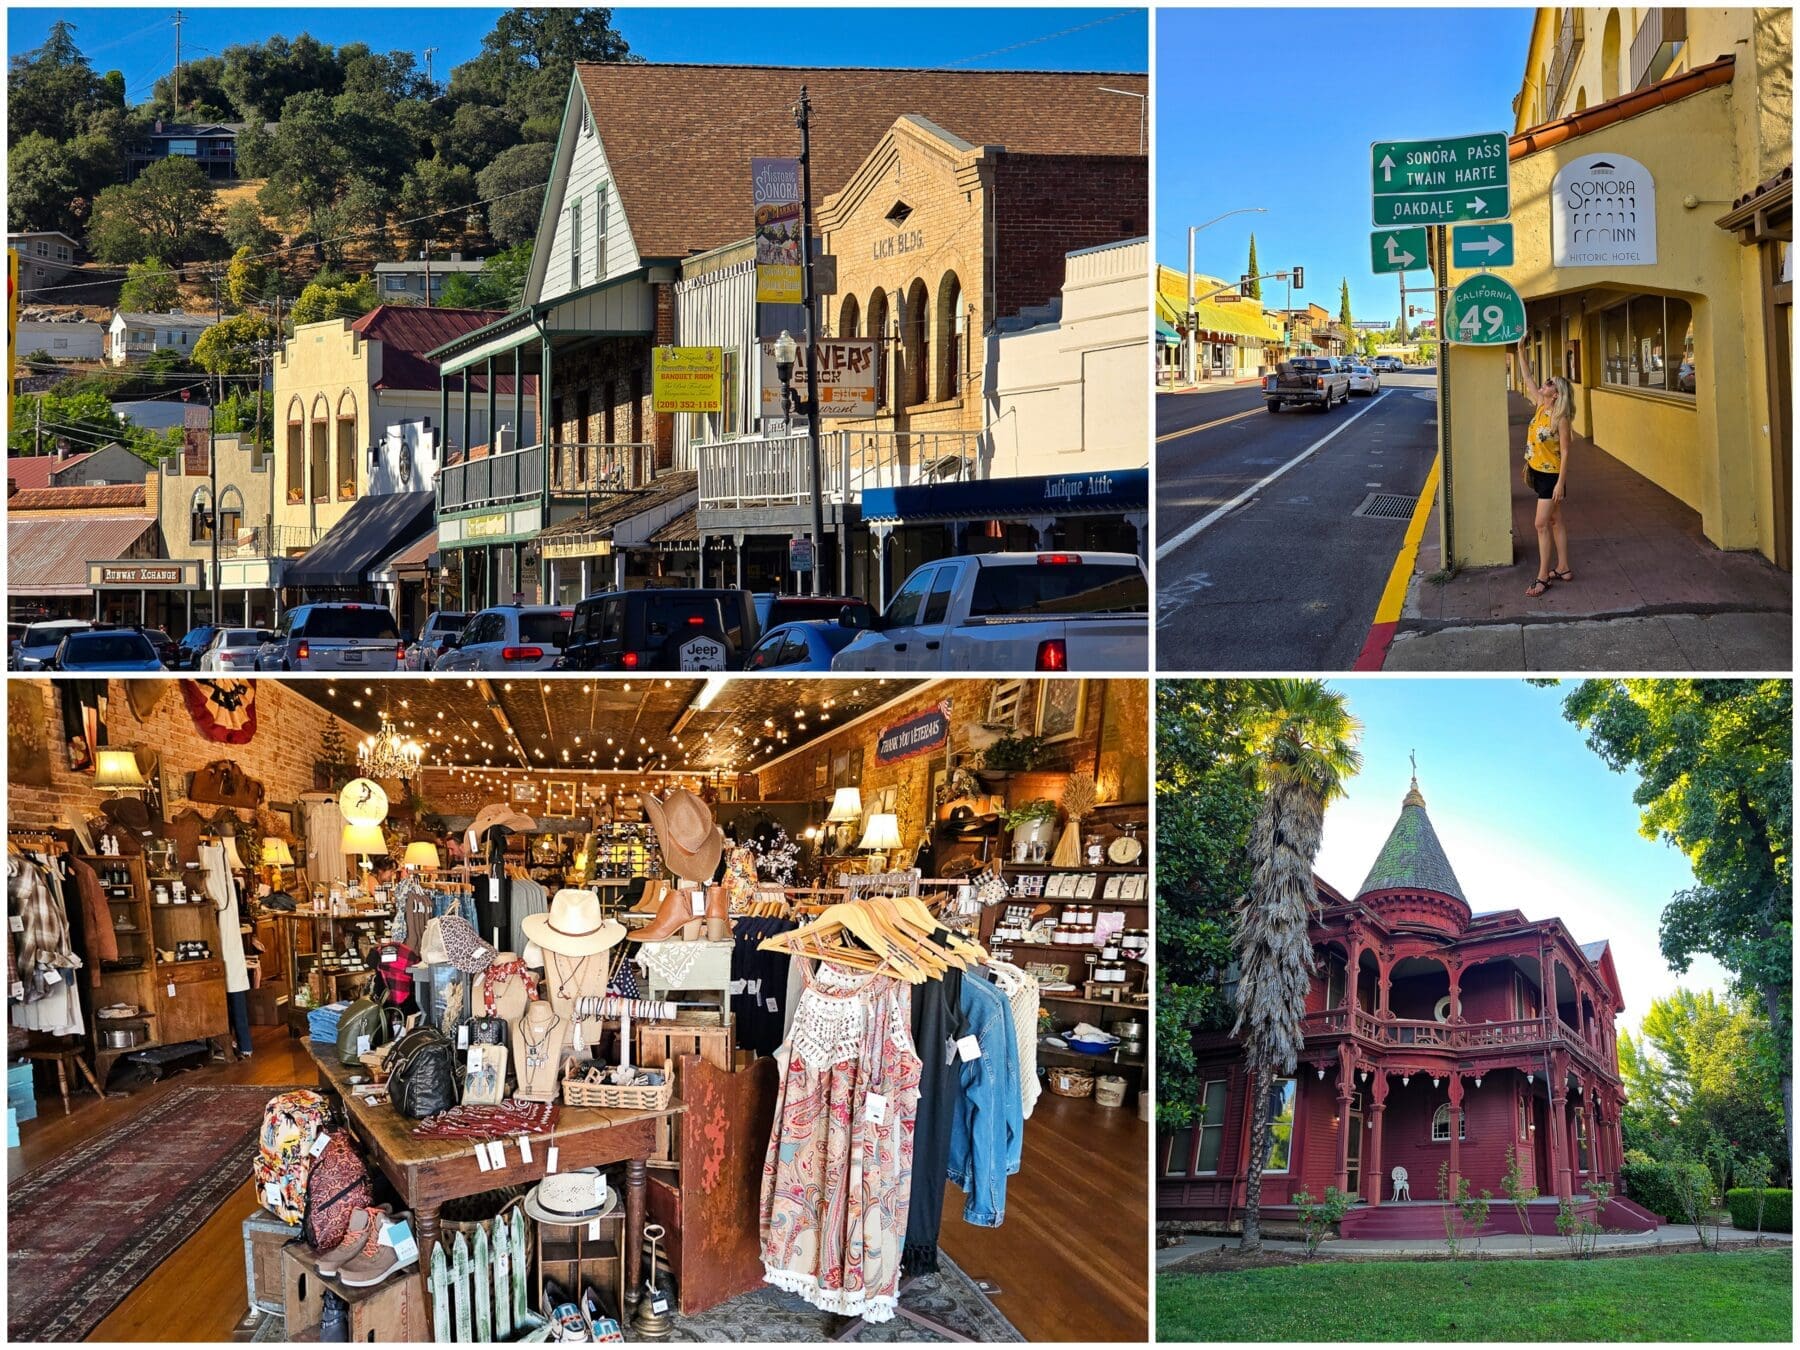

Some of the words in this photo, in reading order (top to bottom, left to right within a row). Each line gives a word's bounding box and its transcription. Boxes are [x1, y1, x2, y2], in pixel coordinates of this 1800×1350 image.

[1406, 149, 1457, 165] SONORA
[1467, 144, 1500, 160] PASS
[1407, 171, 1446, 185] TWAIN
[1455, 166, 1497, 183] HARTE
[755, 176, 799, 201] SONORA
[1568, 180, 1635, 209] SONORA
[1394, 200, 1454, 216] OAKDALE
[1612, 228, 1636, 242] INN
[873, 236, 895, 260] LICK
[1570, 253, 1607, 262] HISTORIC
[1612, 252, 1640, 261] HOTEL
[1456, 290, 1512, 303] CALIFORNIA
[1459, 304, 1504, 336] 49
[795, 343, 873, 374] NERS
[657, 400, 678, 409] (209)
[679, 400, 719, 409] 352-1165
[1044, 478, 1083, 501] Antique
[1086, 475, 1113, 496] Attic
[105, 568, 136, 580] RUNWAY
[140, 568, 177, 580] XCHANGE
[687, 643, 718, 656] Jeep
[881, 735, 899, 753] THANK
[899, 730, 910, 748] YOU
[910, 720, 940, 744] VETERANS
